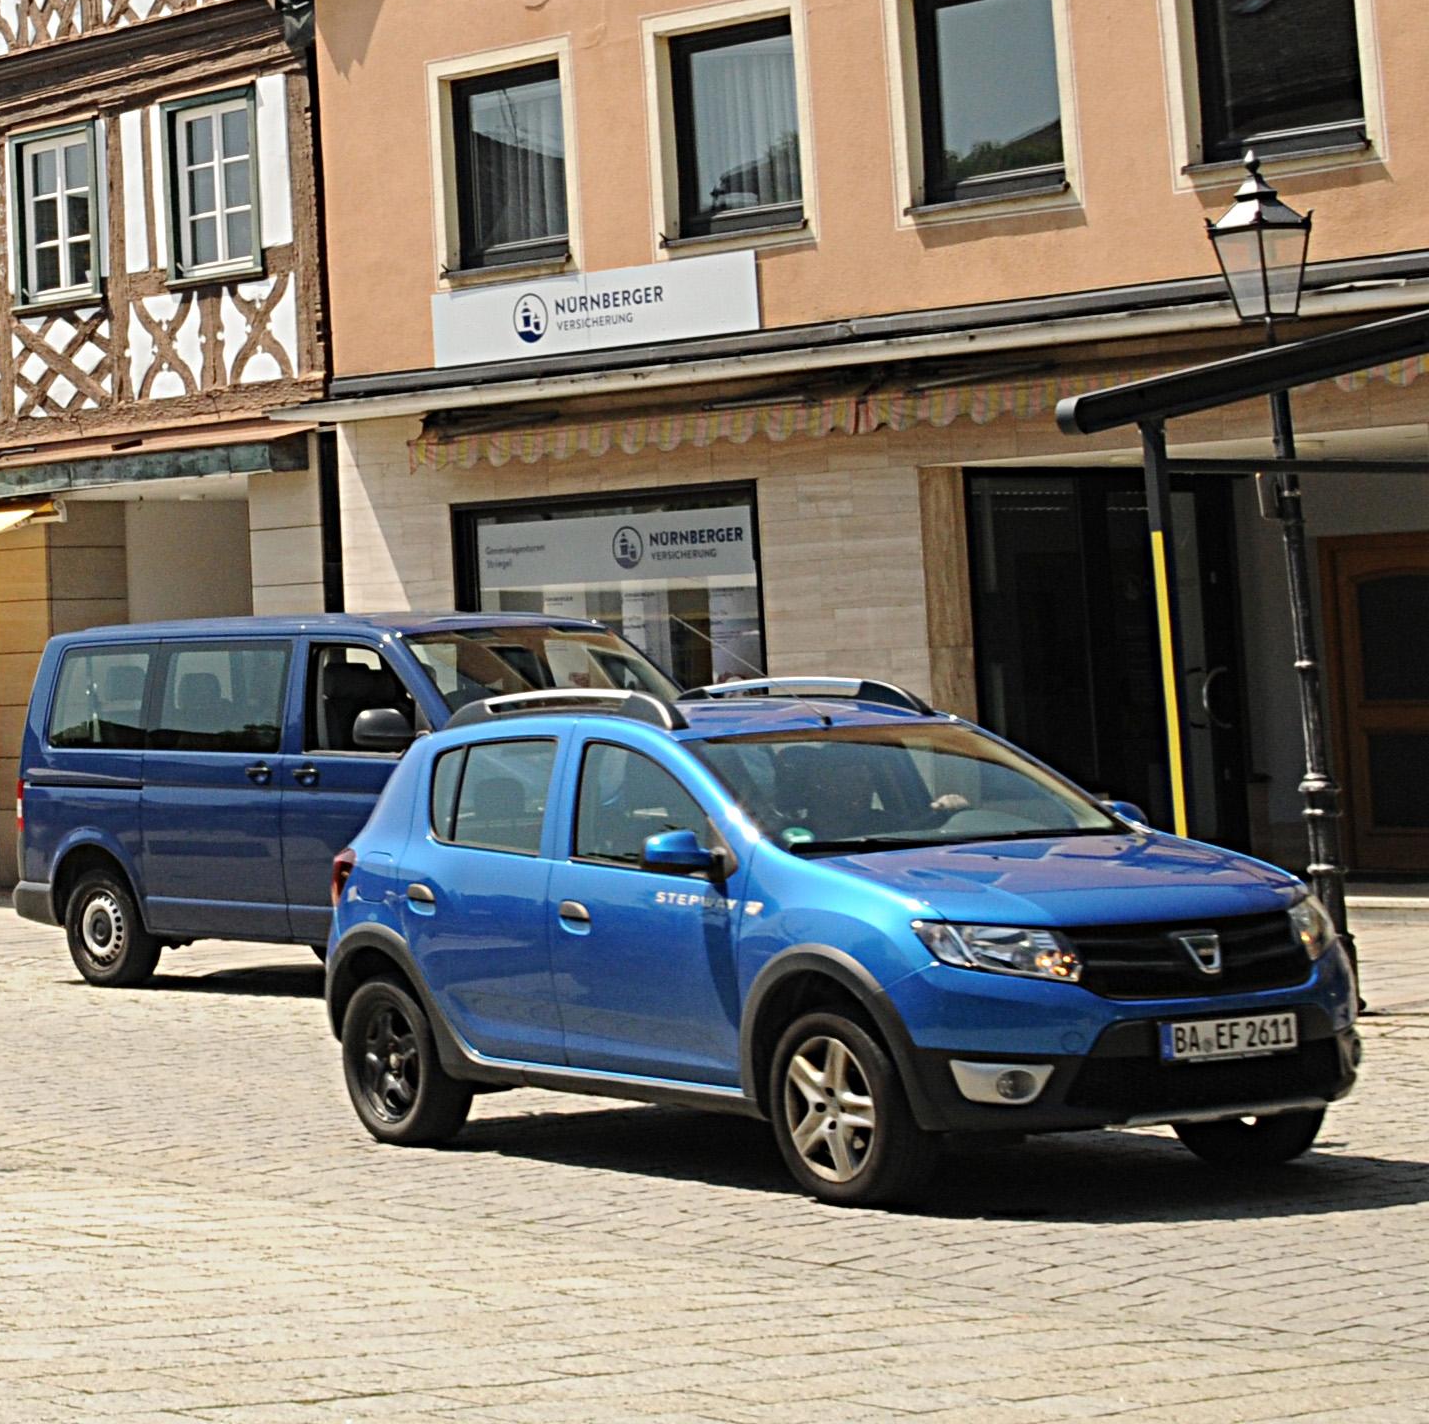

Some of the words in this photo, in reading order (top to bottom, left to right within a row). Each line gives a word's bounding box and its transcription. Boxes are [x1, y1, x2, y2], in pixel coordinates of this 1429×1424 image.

[554, 285, 663, 315] NÜRNBERGER
[557, 312, 633, 331] VERSICHERUNG
[649, 527, 744, 547] NÜRNBERGER
[652, 548, 717, 561] VERSICHERUNG
[655, 891, 738, 910] STEPWAY
[1174, 1025, 1200, 1053] BA
[1215, 1022, 1240, 1050] EF
[1245, 1017, 1294, 1047] 2611
